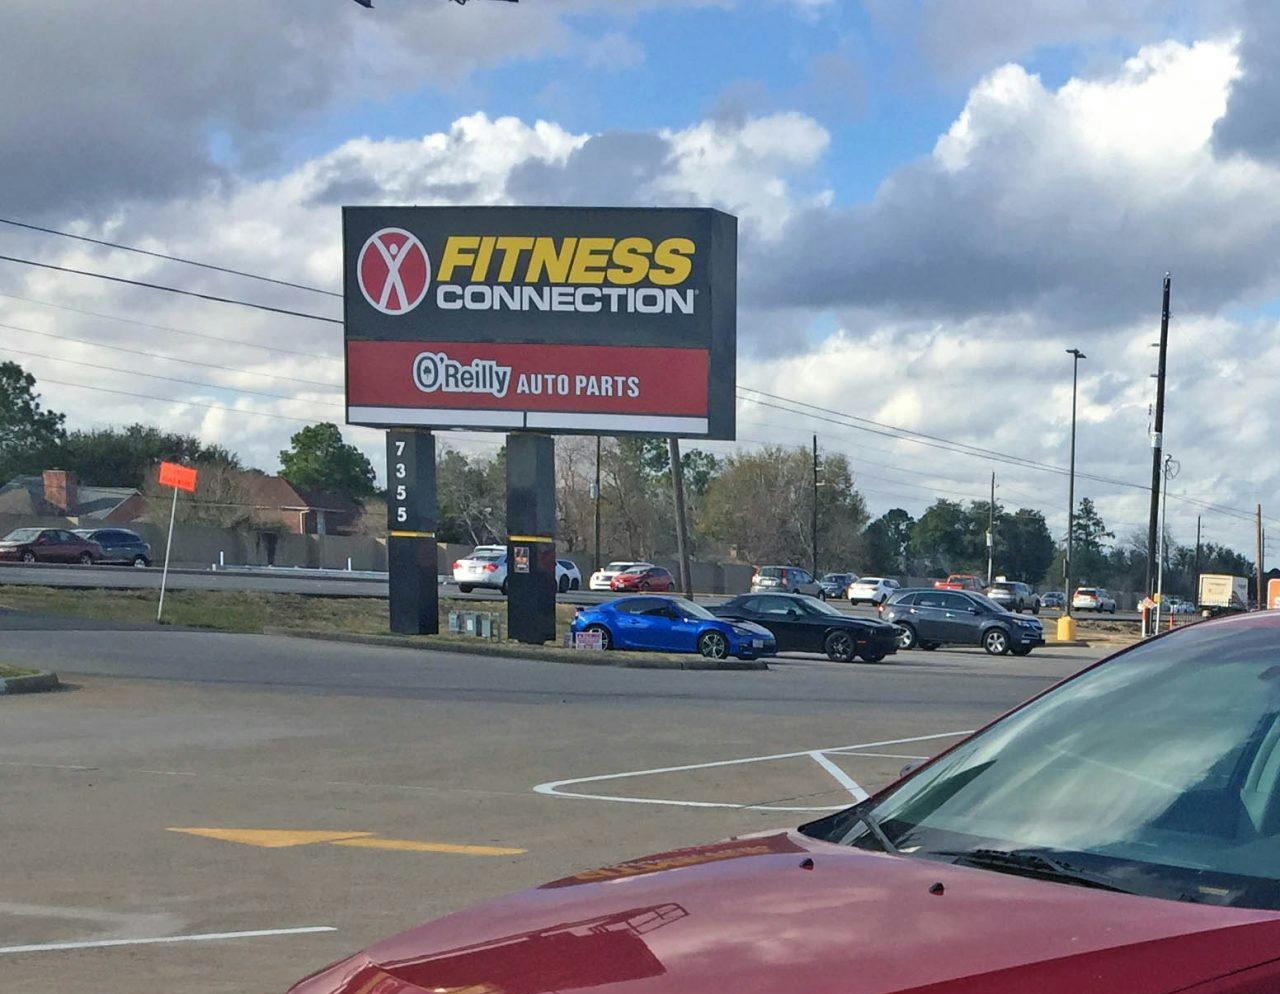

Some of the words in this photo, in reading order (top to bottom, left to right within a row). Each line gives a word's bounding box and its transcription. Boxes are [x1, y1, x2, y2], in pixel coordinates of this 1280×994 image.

[437, 236, 696, 285] FITNESS
[436, 284, 695, 314] CONNECTION
[415, 354, 509, 396] O'Reilly
[517, 373, 570, 396] AUTO
[575, 374, 641, 398] PARTS
[395, 441, 407, 522] 7355
